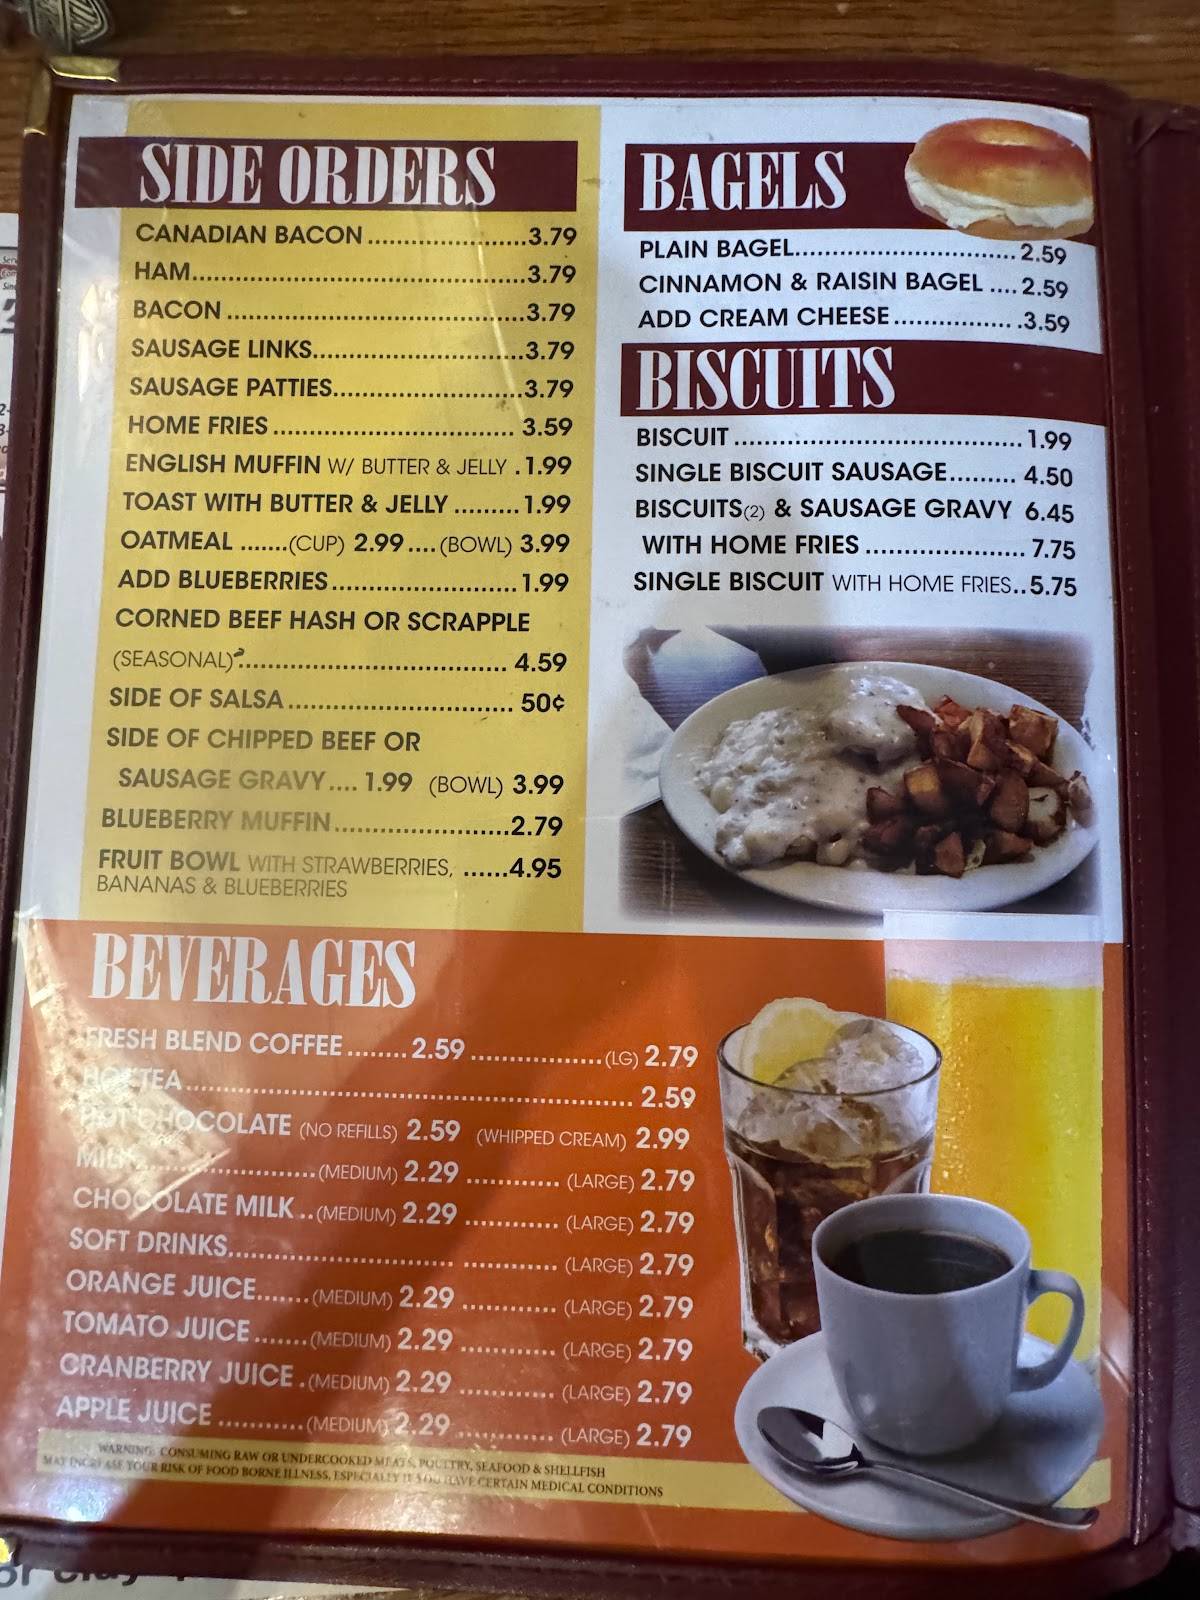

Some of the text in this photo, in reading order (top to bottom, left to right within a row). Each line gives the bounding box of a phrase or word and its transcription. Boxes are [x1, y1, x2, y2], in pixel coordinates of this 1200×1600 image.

[140, 144, 495, 207] SIDE ORDERS
[640, 151, 846, 210] BAGELS
[136, 224, 577, 245] CANADIAN BACON 3.79
[641, 239, 1066, 264] PLAIN BAGEL 2.59
[135, 262, 189, 280] HAM
[640, 272, 1068, 298] CINNAMON RAISIN BAGEL 2.59
[134, 300, 220, 319] BACON
[638, 307, 1069, 333] ADD CREAM CHEESE 3.59
[132, 338, 311, 358] SAUSAGE LINKS
[130, 377, 332, 396] SAUSAGE PATTIES
[636, 347, 894, 409] BISCUITS
[129, 416, 572, 436] HOME FRIES 3.59
[638, 428, 1071, 450] BISCUIT 1.99
[126, 454, 571, 476] ENGLISH MUFFIN W/ BUTTER JELLY 1.99
[636, 462, 1072, 487] SINGLE BISCUIT SAUSAGE 4.50
[123, 492, 570, 513] TOAST WITH BUTTER JELLY 1.99
[775, 499, 791, 517] &
[801, 498, 915, 517] SAUSAGE
[925, 499, 1012, 519] GRAVY
[1026, 502, 1074, 523] 6.45
[121, 530, 569, 558] OATMEAL (CUP) 2.99 (BOWL) 3.99
[642, 535, 1075, 560] WITH HOME FRIES 7.75
[118, 570, 569, 592] ADD BLUEBERRIES 1.99
[634, 572, 1076, 596] SINGLE BISCUIT WITH HOME FRIES 5.75
[116, 608, 529, 631] CORNED BEEF HASH OR SCRAPPLE
[114, 650, 567, 673] (SEASONAL) 4.59
[110, 687, 564, 712] SIDE OF SALSA 50¢
[107, 727, 420, 751] SIDE CHIPPED BEEF OR
[119, 768, 564, 799] SAUSAGE GRAVY 1.99 (BOWL) 3.99
[102, 808, 562, 836] BLUEBERRY MUFFIN 2.79
[99, 849, 162, 869] FRUIT
[171, 850, 240, 871] BOWL
[510, 858, 561, 878] 4.95
[97, 875, 347, 897] BANANAS BLUEBERRIES
[90, 933, 416, 1008] BEVERAGES
[84, 1027, 698, 1070] FRESH BLEND COFFEE 2.59 (LG) 2.79
[140, 1068, 696, 1108] TEA 2.59
[137, 1109, 689, 1152] CHOCOLATE (NO REFILLS) 2.59 (WHIPPED CREAM) 2.99
[319, 1160, 694, 1191] (MEDIUM) 2.29 2.79
[73, 1187, 694, 1233] CHOCOLATE MILK 2.29 2.79
[69, 1227, 694, 1276] SOFT DRINKS 2.79
[66, 1269, 454, 1308] ORANGE JUICE 2.29
[63, 1311, 692, 1361] TOMATO JUICE 2.29 2.79
[60, 1353, 451, 1393] CRANBERRY JUICE 2.29
[56, 1396, 691, 1447] APPLE JUICE 2.29 2.79
[161, 1447, 605, 1478] CONSUMING RAW OR UNDERCOOKED SEAFOOD & SHELLFISH
[161, 1463, 663, 1496] RISK OF FOOD BORNE CERTAIN MEDICAL CONDITIONS
